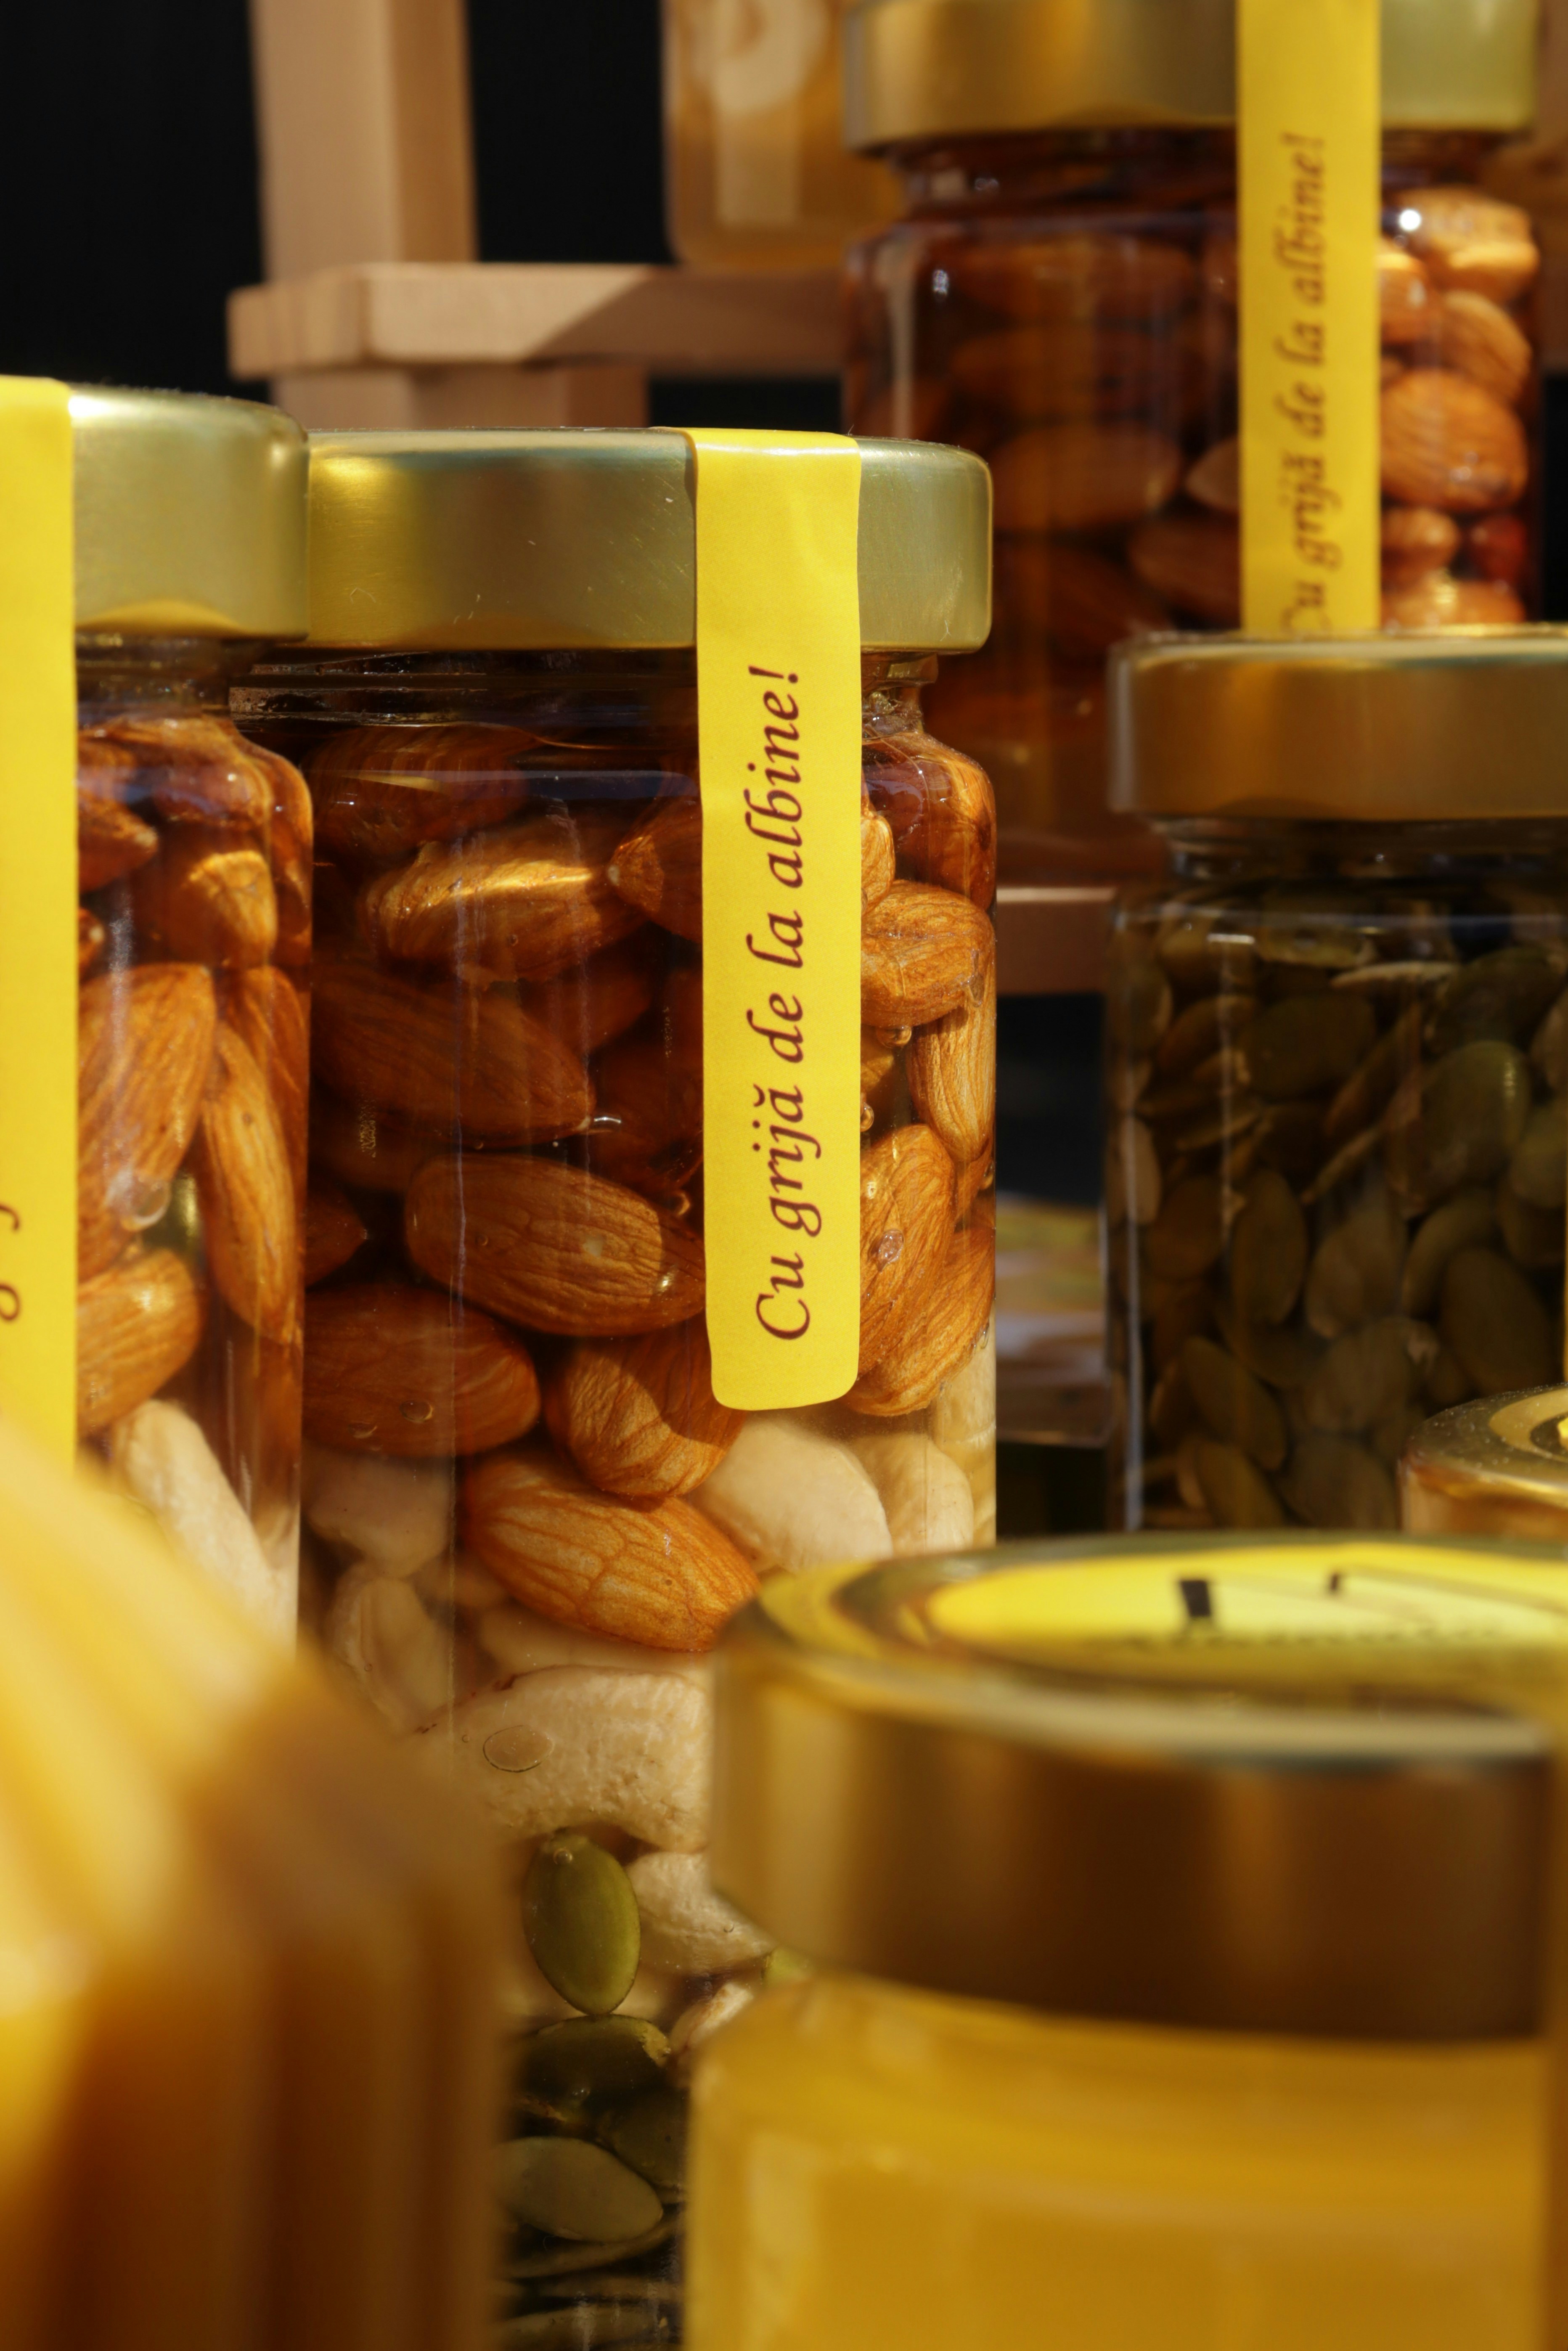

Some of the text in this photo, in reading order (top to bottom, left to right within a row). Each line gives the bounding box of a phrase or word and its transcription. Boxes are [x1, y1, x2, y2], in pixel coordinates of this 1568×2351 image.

[1272, 130, 1327, 307] albine!
[1271, 320, 1327, 369] la
[1272, 381, 1327, 442] de
[1279, 451, 1343, 573] grijă
[742, 665, 823, 1341] Cu grijă de la albine!
